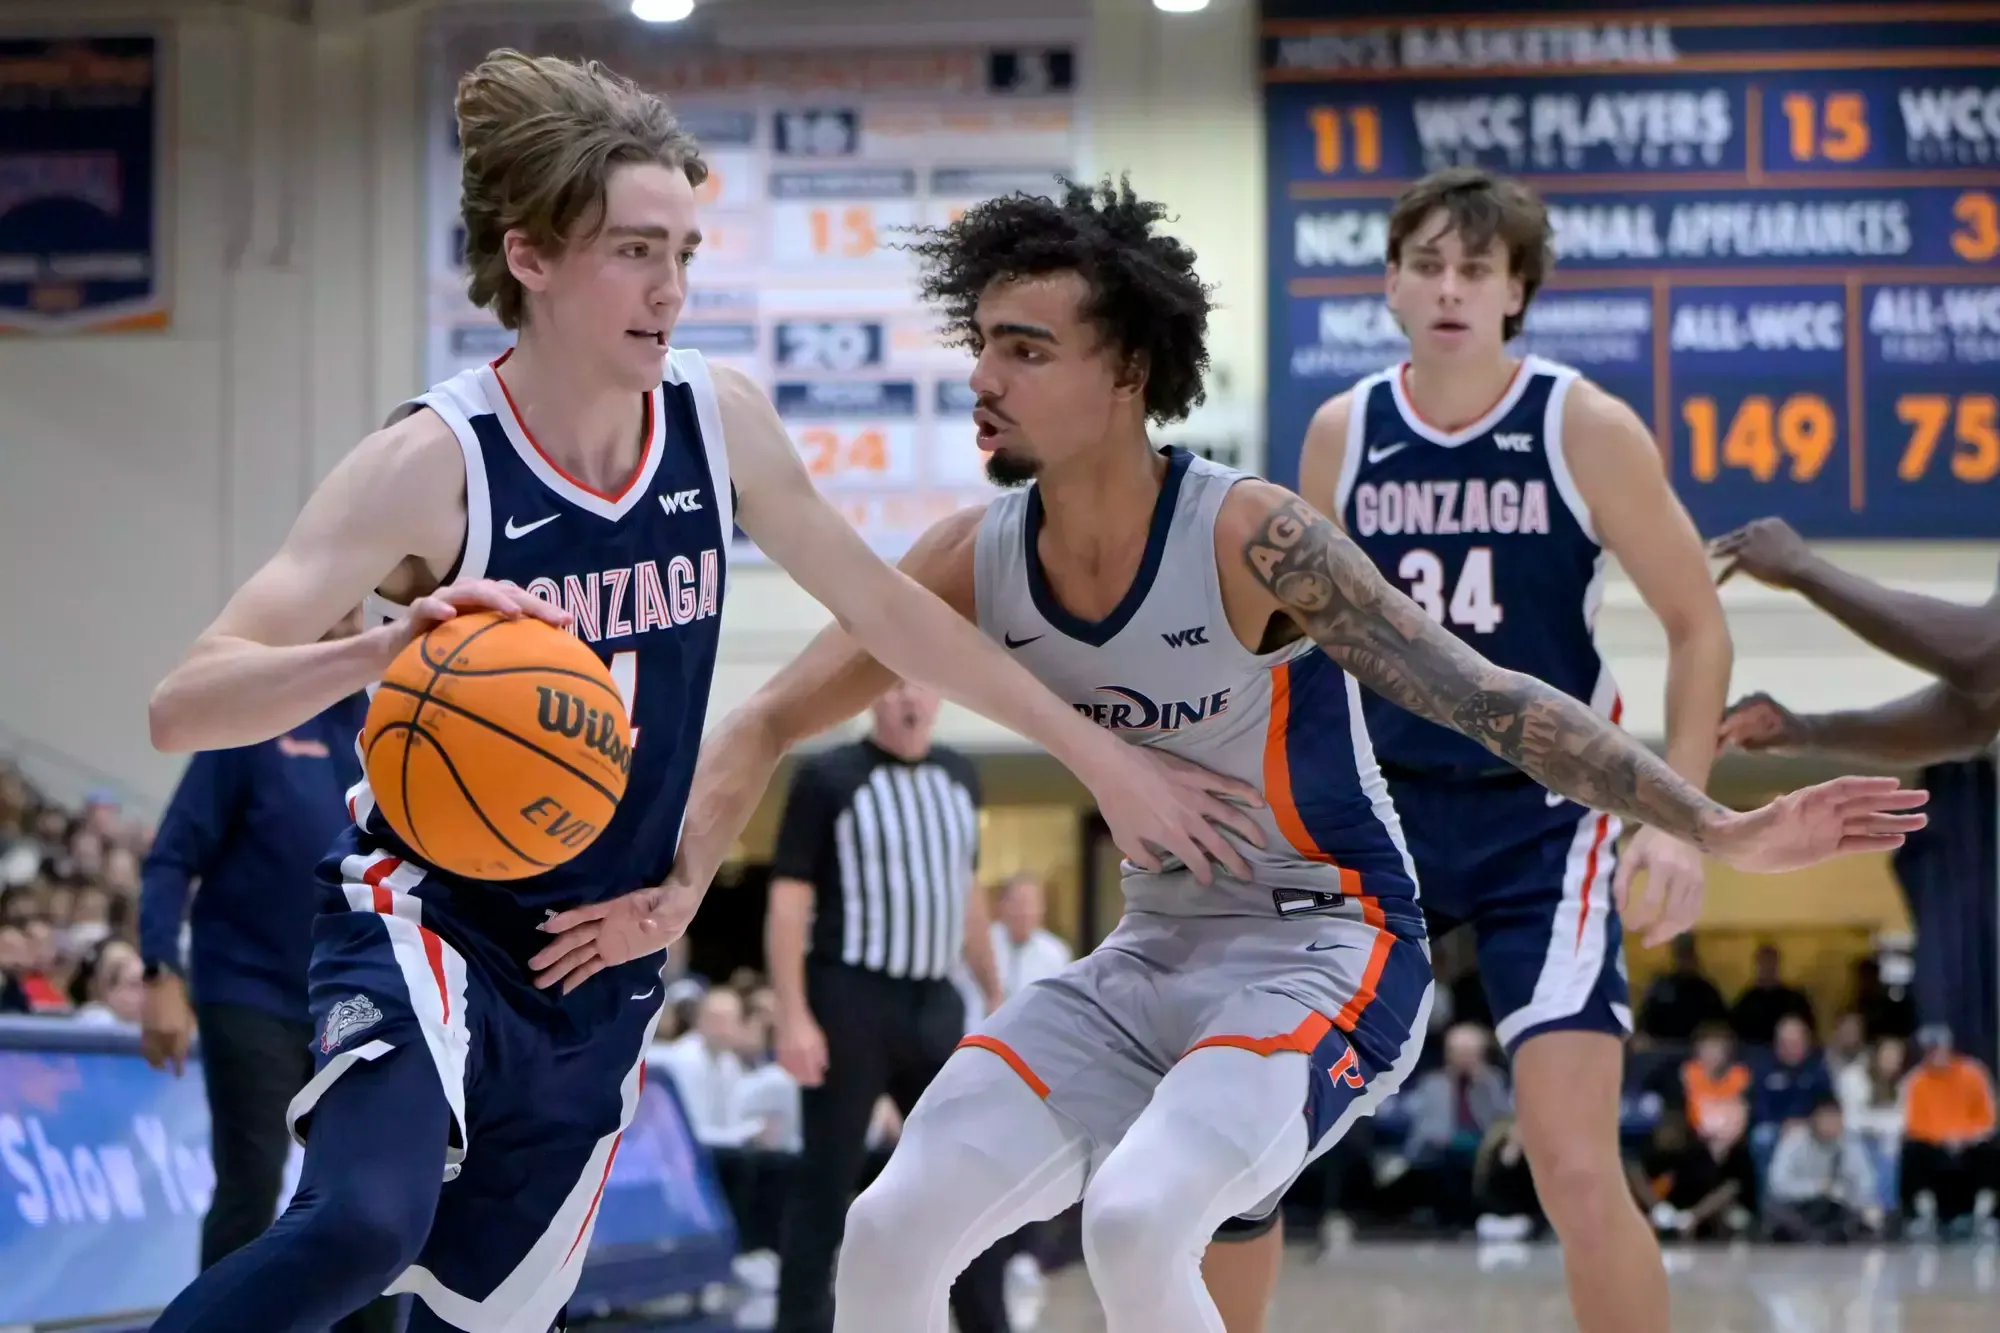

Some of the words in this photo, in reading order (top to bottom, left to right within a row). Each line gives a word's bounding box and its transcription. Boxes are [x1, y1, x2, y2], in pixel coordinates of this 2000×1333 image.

[1400, 23, 1676, 67] BASKETBALL
[1310, 107, 1380, 173] 11
[1413, 96, 1523, 150] WCC
[1530, 90, 1731, 148] PLAYERS
[1783, 91, 1869, 162] 15
[810, 206, 877, 255] 15
[1294, 209, 1388, 266] NCA
[1671, 302, 1844, 351] ALL-WCC
[800, 428, 888, 476] 24
[1682, 393, 1837, 483] 149
[1896, 392, 2000, 482] 75
[658, 489, 703, 516] WCC
[1356, 478, 1551, 538] GONZAGA
[1398, 546, 1504, 634] 34
[1161, 626, 1210, 649] WCC
